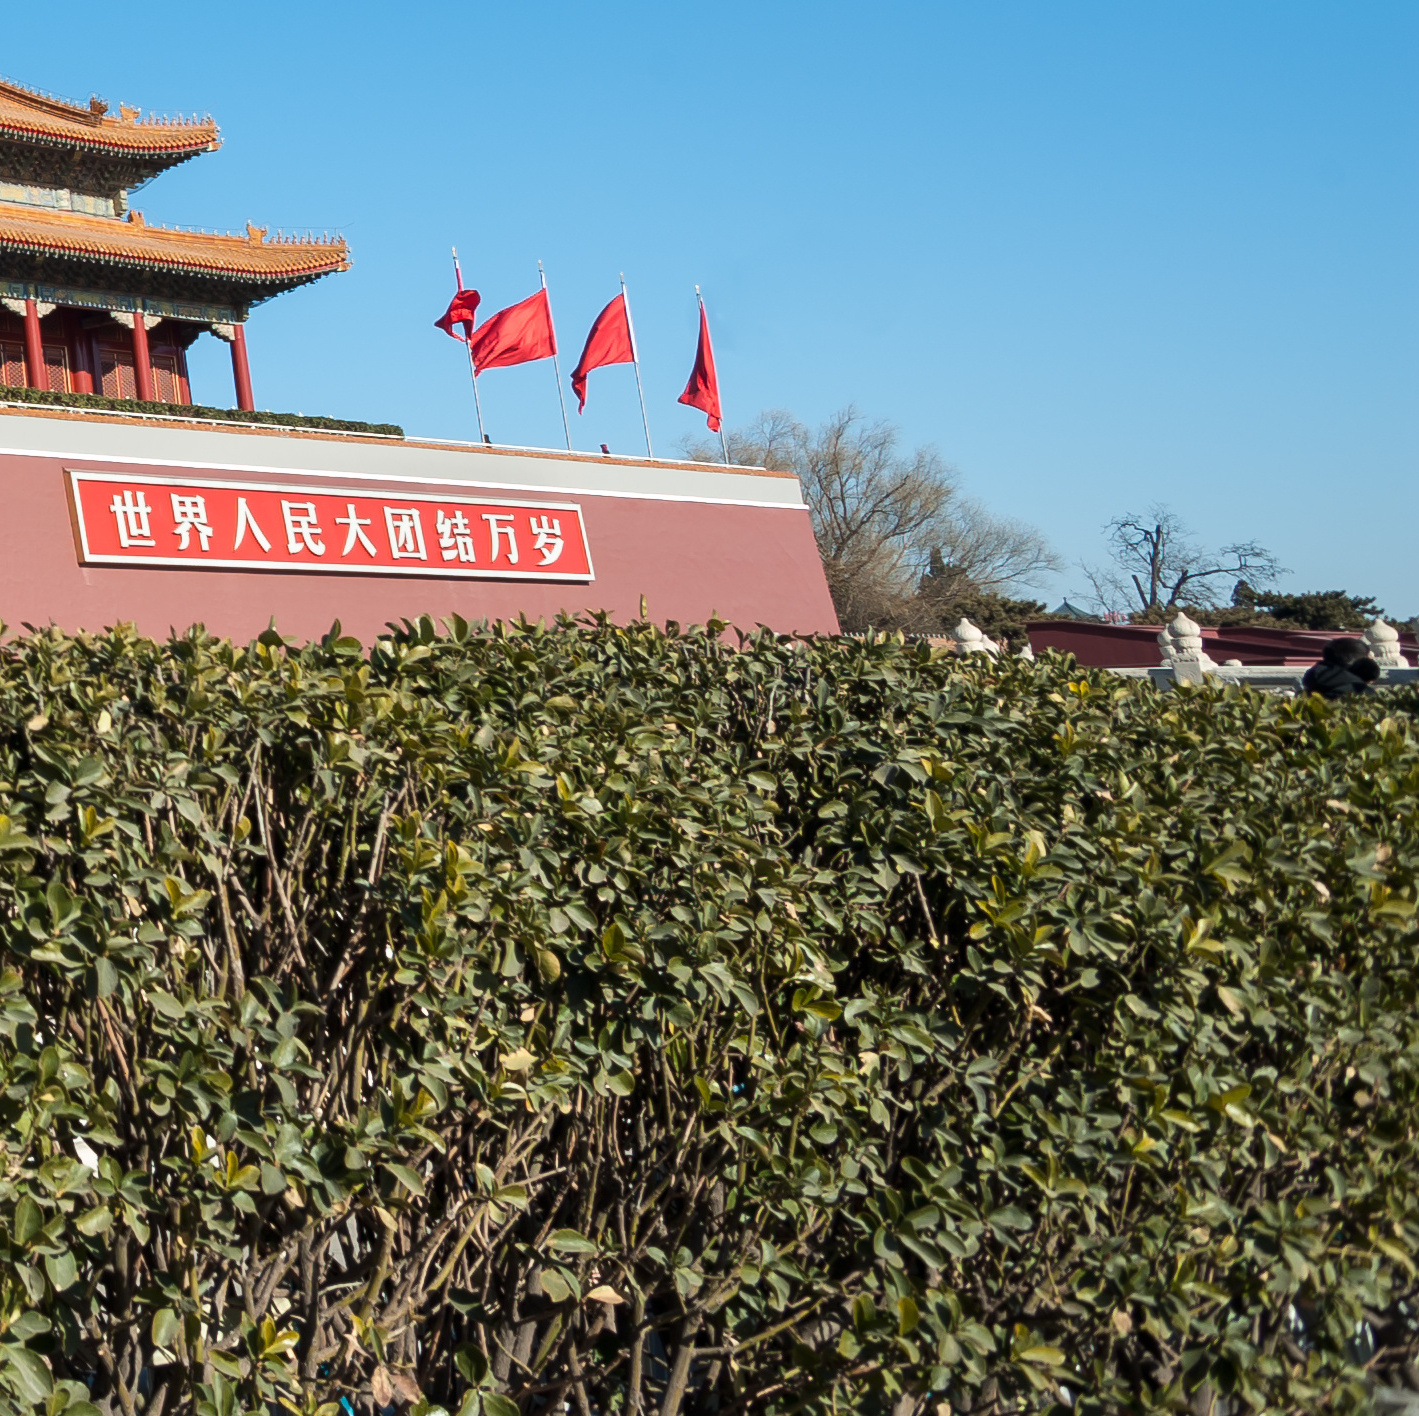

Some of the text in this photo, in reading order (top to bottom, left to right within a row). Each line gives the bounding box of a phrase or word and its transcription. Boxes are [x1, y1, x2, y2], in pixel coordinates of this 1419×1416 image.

[109, 489, 565, 566] 世界人民大团结万岁
